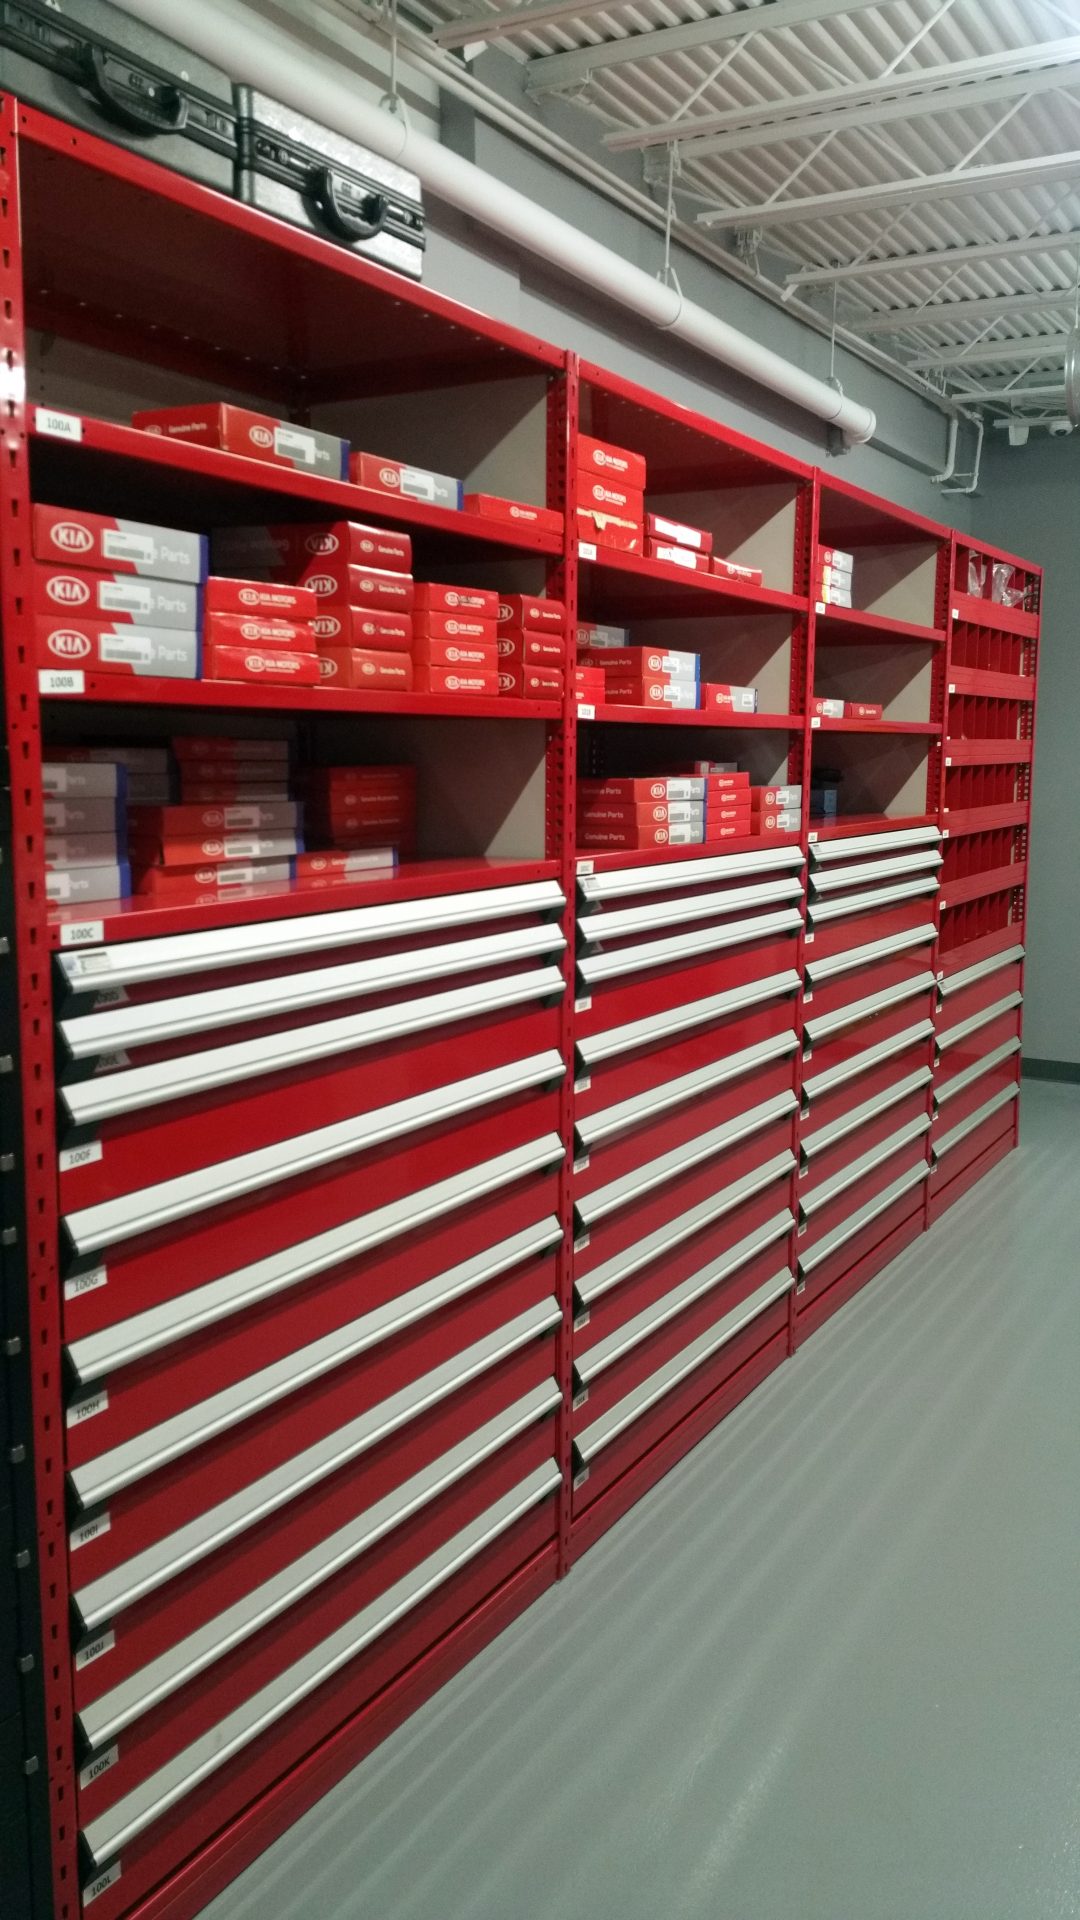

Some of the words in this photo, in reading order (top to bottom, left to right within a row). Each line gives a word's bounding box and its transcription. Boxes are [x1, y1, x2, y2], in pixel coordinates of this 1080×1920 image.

[47, 416, 71, 433] 100A
[251, 427, 271, 446] KIA
[381, 470, 398, 485] KIA
[56, 524, 89, 549] KIA
[160, 545, 191, 565] Parts
[52, 579, 84, 602] KIA
[157, 595, 187, 613] Parts
[54, 634, 86, 654] KIA
[158, 644, 188, 662] Parts
[50, 676, 74, 688] 100B
[606, 787, 621, 795] Parts
[607, 810, 624, 819] Parts
[584, 833, 608, 841] Genuine
[609, 833, 625, 841] Parts
[70, 927, 94, 941] 100C
[69, 1149, 91, 1165] 100F
[74, 1273, 99, 1292] 100G
[76, 1400, 100, 1420] 100H
[89, 1758, 111, 1780] 100K
